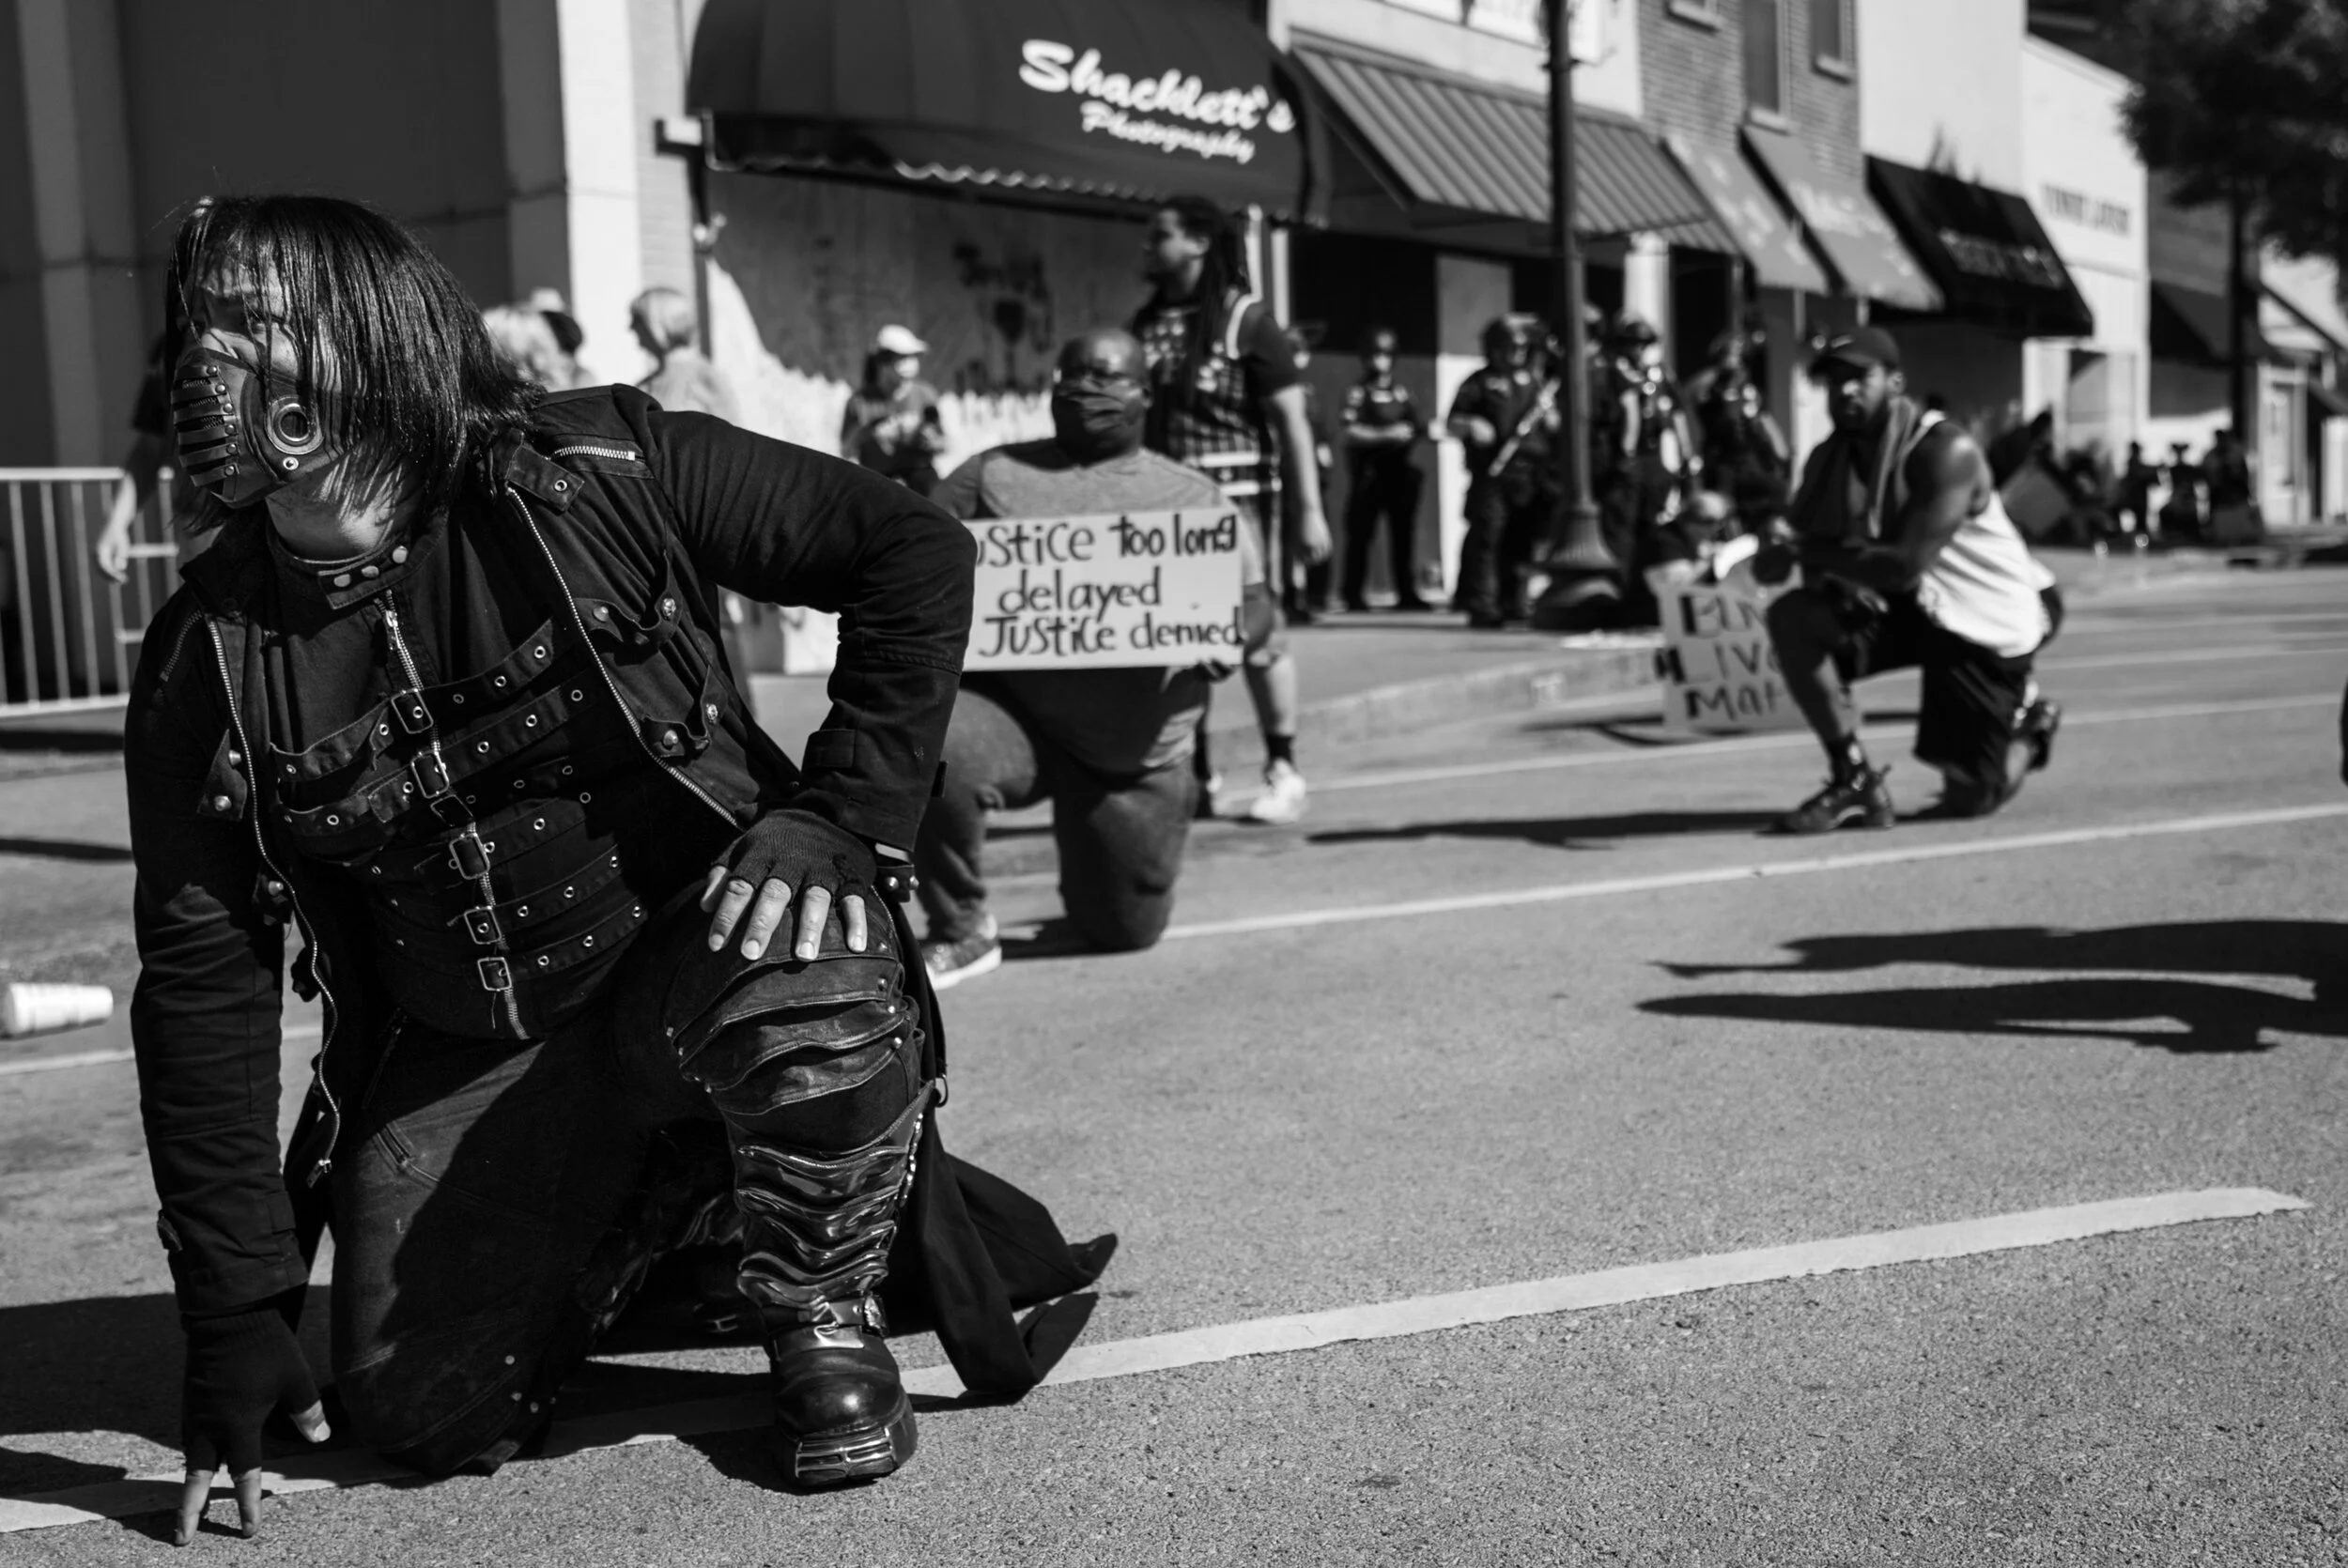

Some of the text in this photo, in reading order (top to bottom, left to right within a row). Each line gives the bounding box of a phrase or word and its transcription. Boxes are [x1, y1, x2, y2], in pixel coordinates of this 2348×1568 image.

[1019, 38, 1295, 133] Shacklett's
[1080, 100, 1256, 164] Photography
[976, 513, 1237, 568] ustice too long
[996, 565, 1162, 623] delayed
[978, 606, 1244, 656] Justice denied
